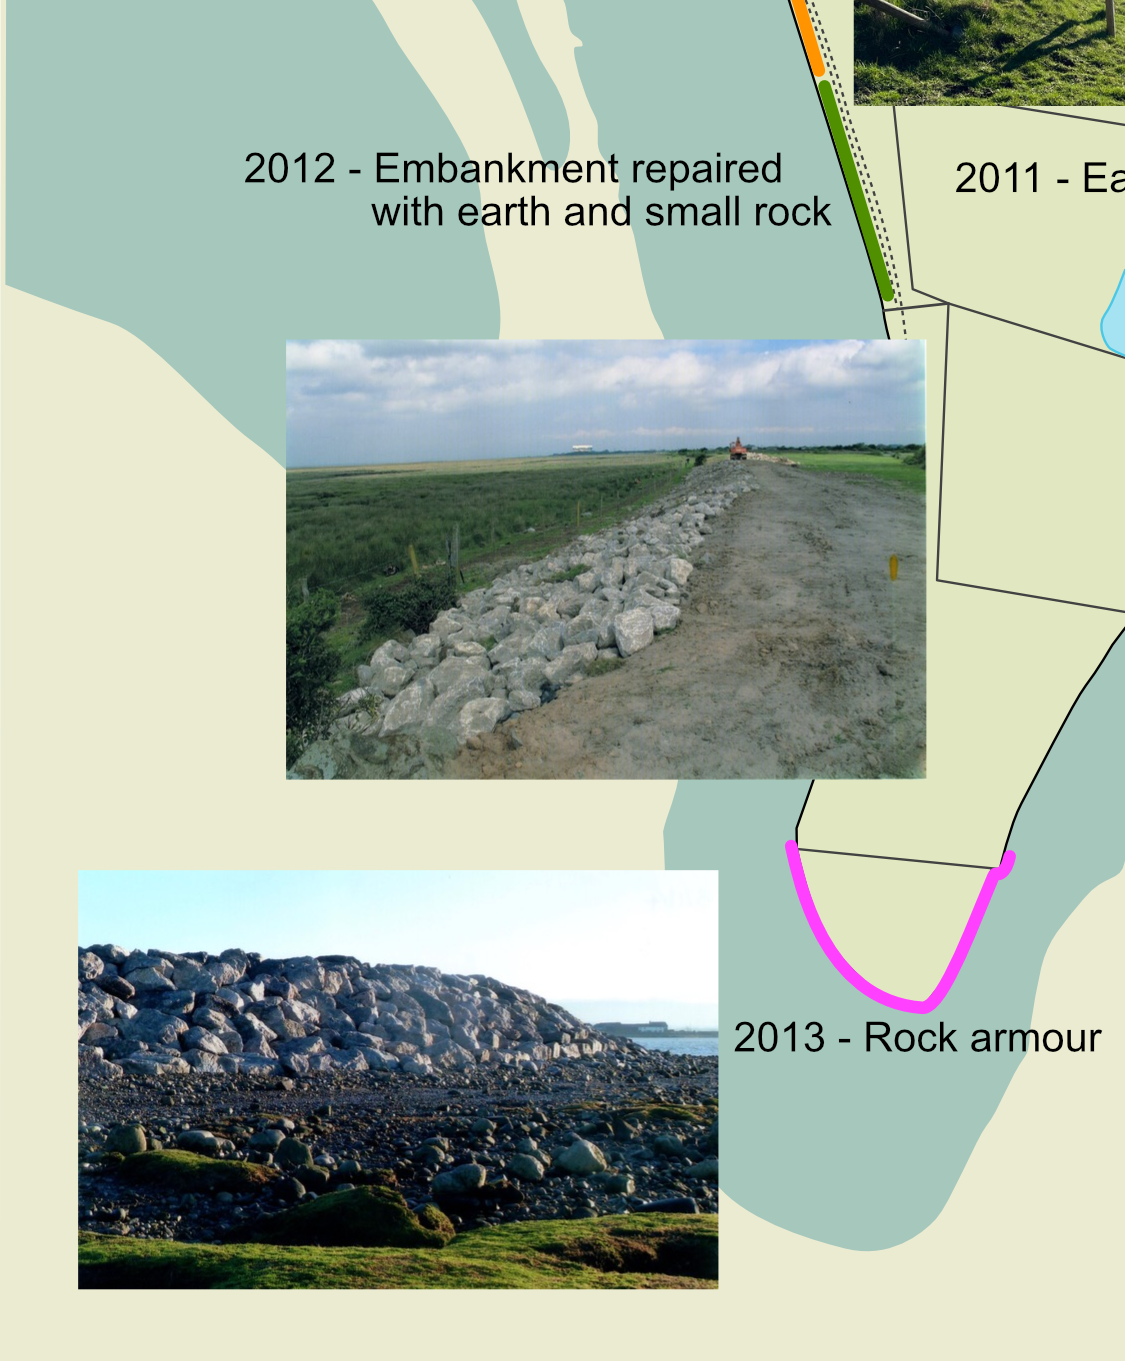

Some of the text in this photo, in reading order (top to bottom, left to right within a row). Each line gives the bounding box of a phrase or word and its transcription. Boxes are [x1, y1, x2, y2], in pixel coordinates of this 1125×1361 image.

[244, 152, 335, 184] 2012
[376, 152, 619, 184] Embankment
[633, 152, 781, 191] repaired
[955, 161, 1037, 193] 2011
[371, 195, 832, 227] with earth and small rock
[734, 1021, 825, 1053] 2013
[866, 1021, 958, 1053] Rock
[970, 1029, 1103, 1053] armour
